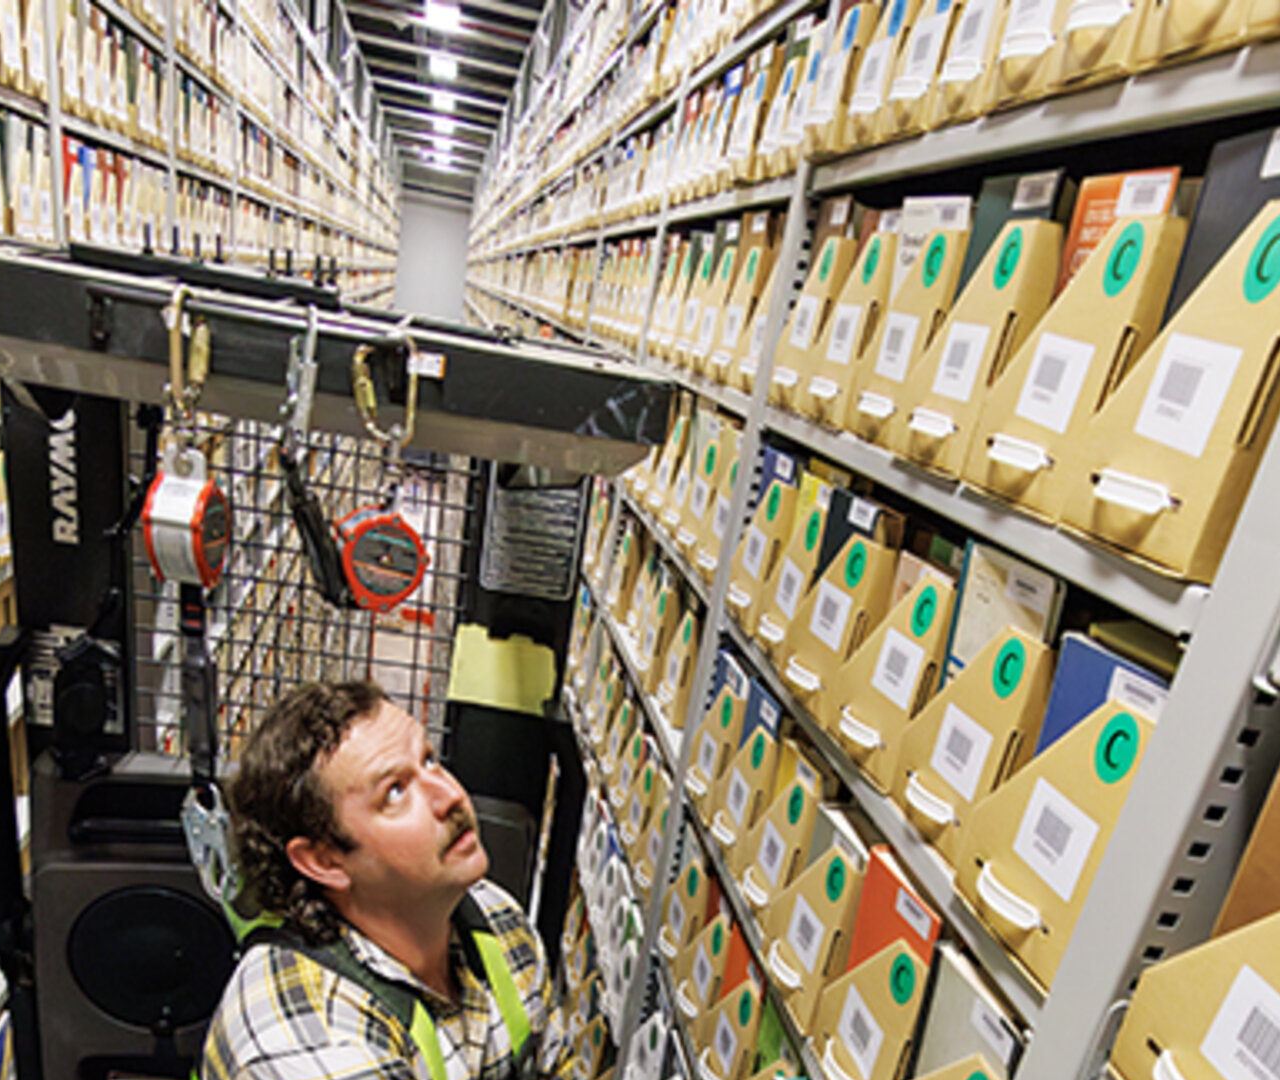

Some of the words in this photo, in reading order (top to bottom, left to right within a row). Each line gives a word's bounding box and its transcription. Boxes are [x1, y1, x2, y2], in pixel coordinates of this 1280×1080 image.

[998, 242, 1018, 278] C
[1111, 239, 1137, 282] C
[848, 552, 862, 579] C
[916, 597, 934, 627] C
[999, 652, 1020, 686] C
[1103, 729, 1130, 769] C
[893, 964, 912, 993] C
